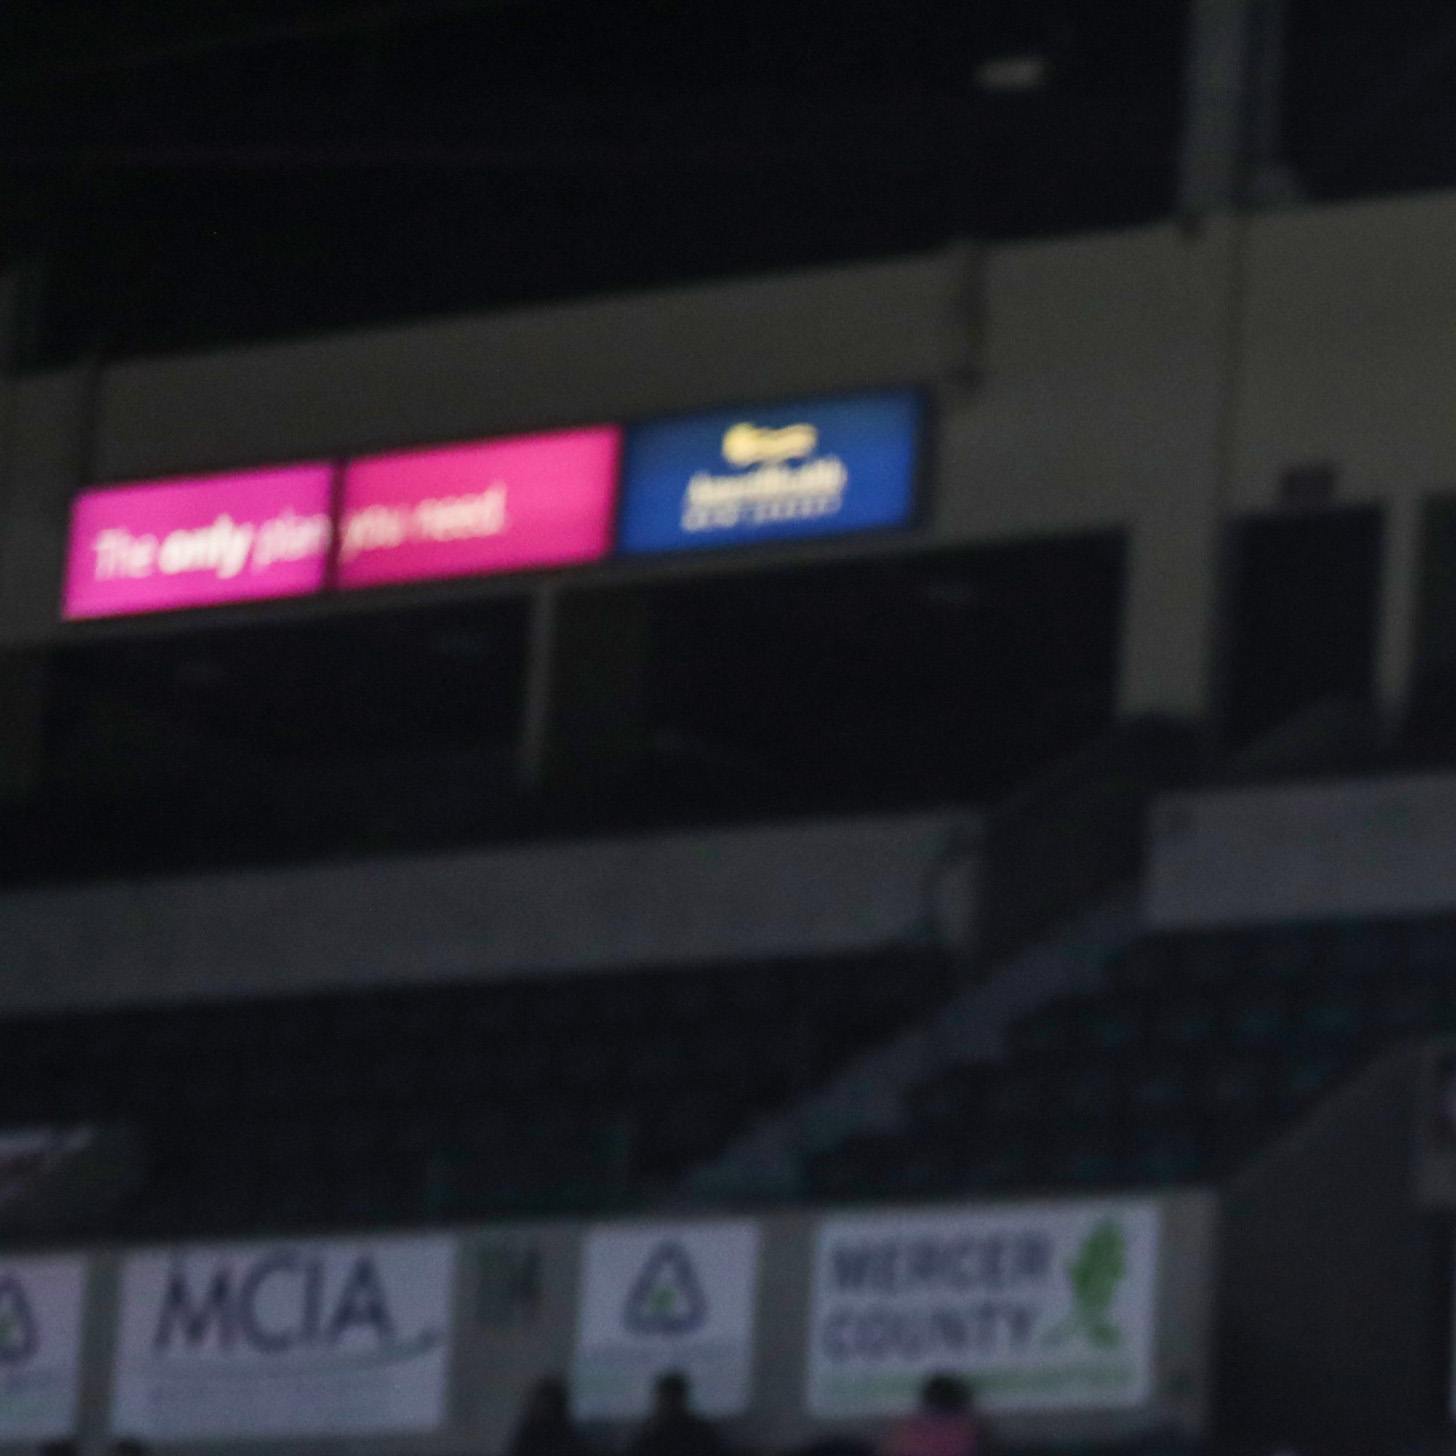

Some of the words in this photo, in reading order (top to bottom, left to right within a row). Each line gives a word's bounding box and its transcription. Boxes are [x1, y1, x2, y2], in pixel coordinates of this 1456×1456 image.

[95, 527, 159, 581] The
[158, 512, 256, 581] only
[832, 1232, 1051, 1294] MERCER
[152, 1248, 398, 1356] MCIA
[823, 1302, 1037, 1361] COUNTY
